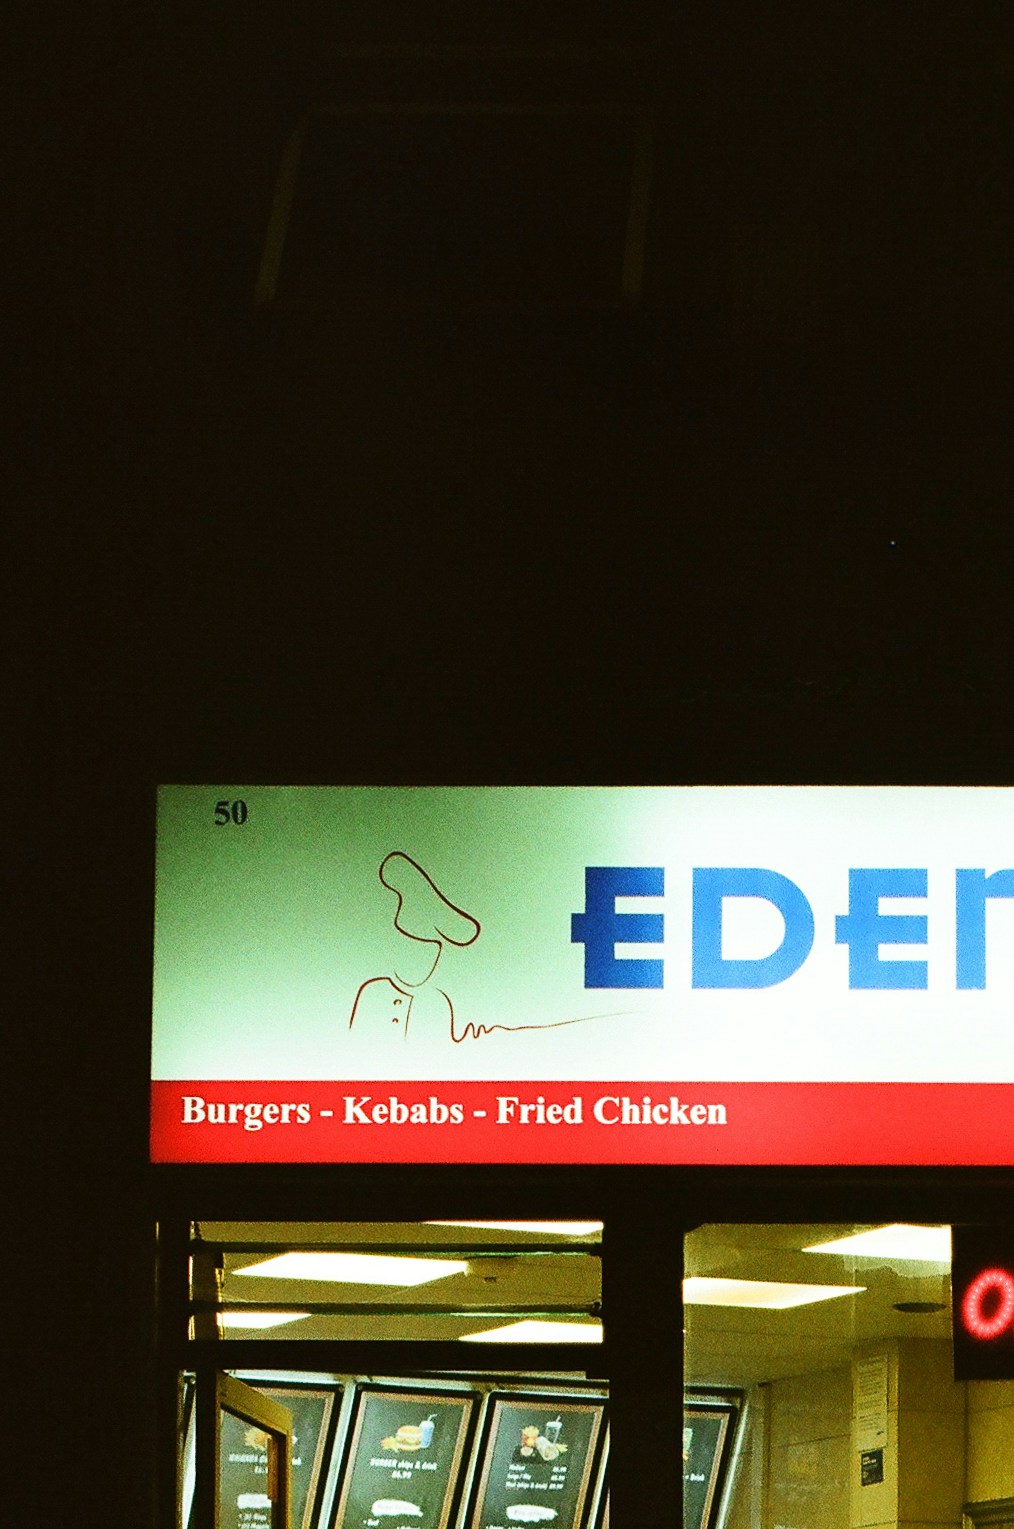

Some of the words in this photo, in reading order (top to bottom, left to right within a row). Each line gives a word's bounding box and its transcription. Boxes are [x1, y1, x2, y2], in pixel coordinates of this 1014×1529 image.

[214, 799, 249, 826] 50
[181, 1096, 311, 1132] Burgers
[342, 1096, 464, 1125] Kebabs
[495, 1096, 584, 1125] Fried
[593, 1096, 728, 1126] Chicken
